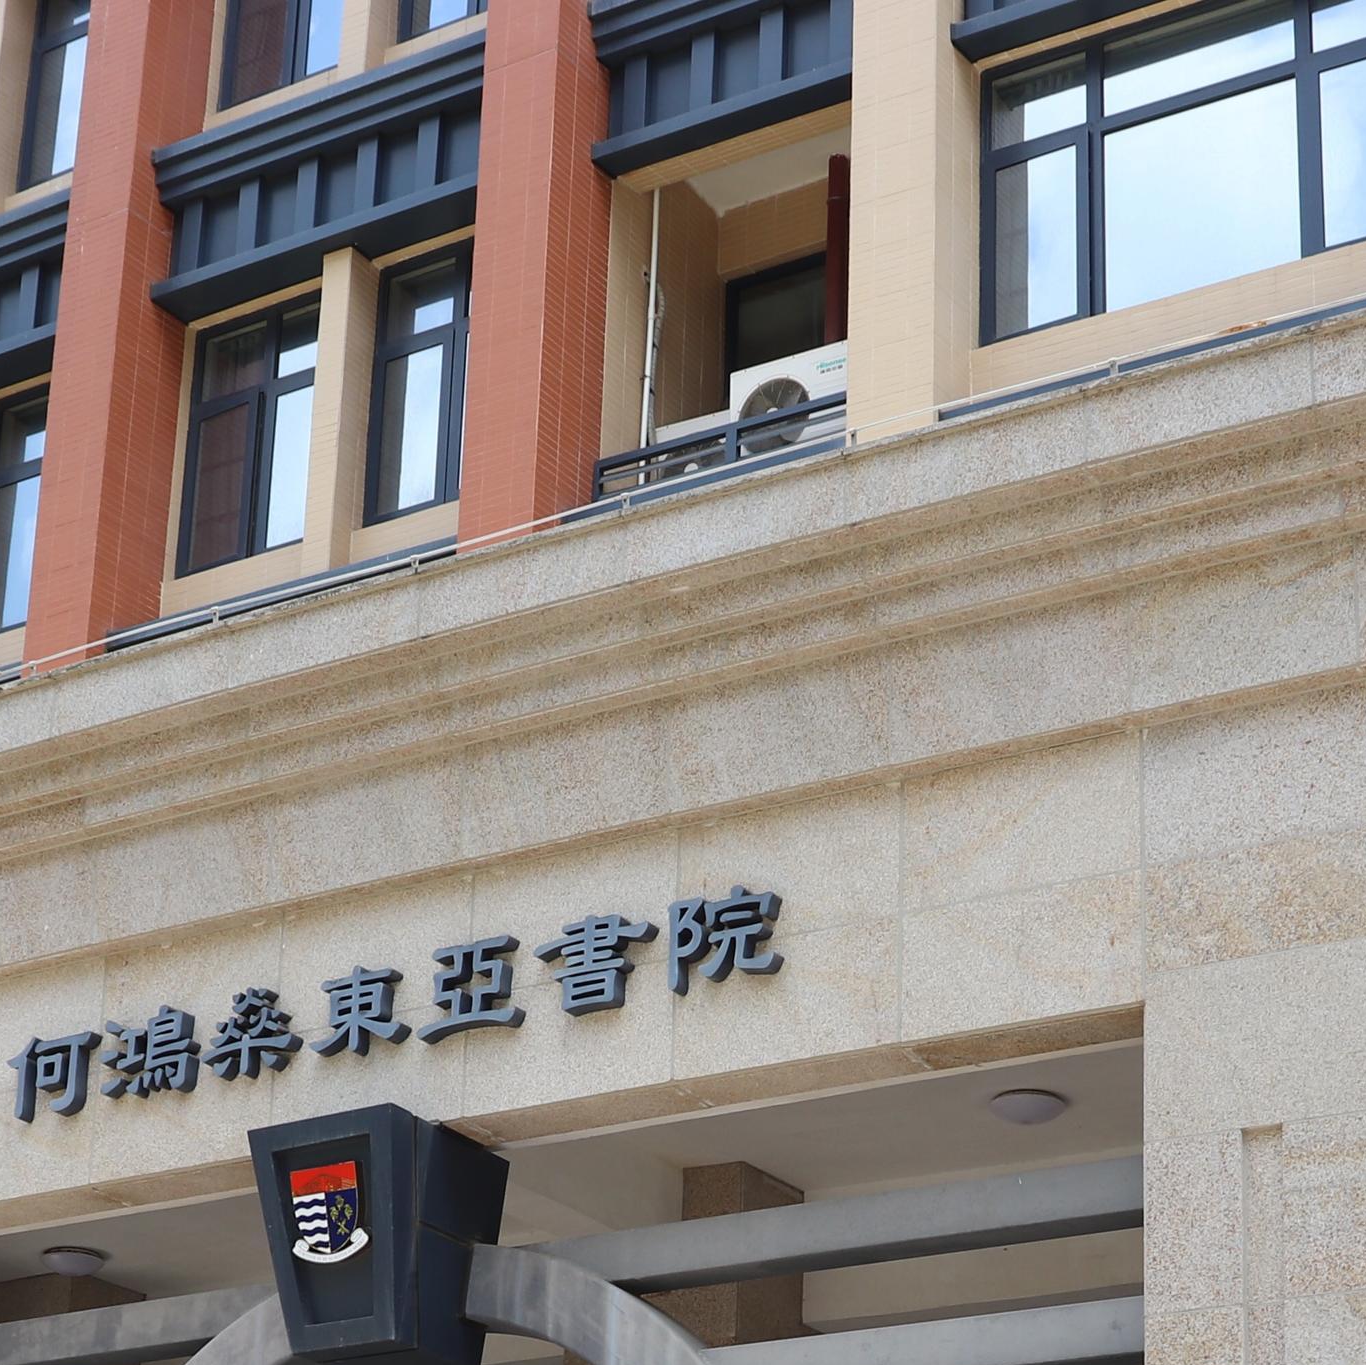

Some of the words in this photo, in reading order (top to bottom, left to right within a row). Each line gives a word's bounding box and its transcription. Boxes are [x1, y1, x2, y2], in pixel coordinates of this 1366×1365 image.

[9, 886, 784, 1123] 何鴻燊東亞書院
